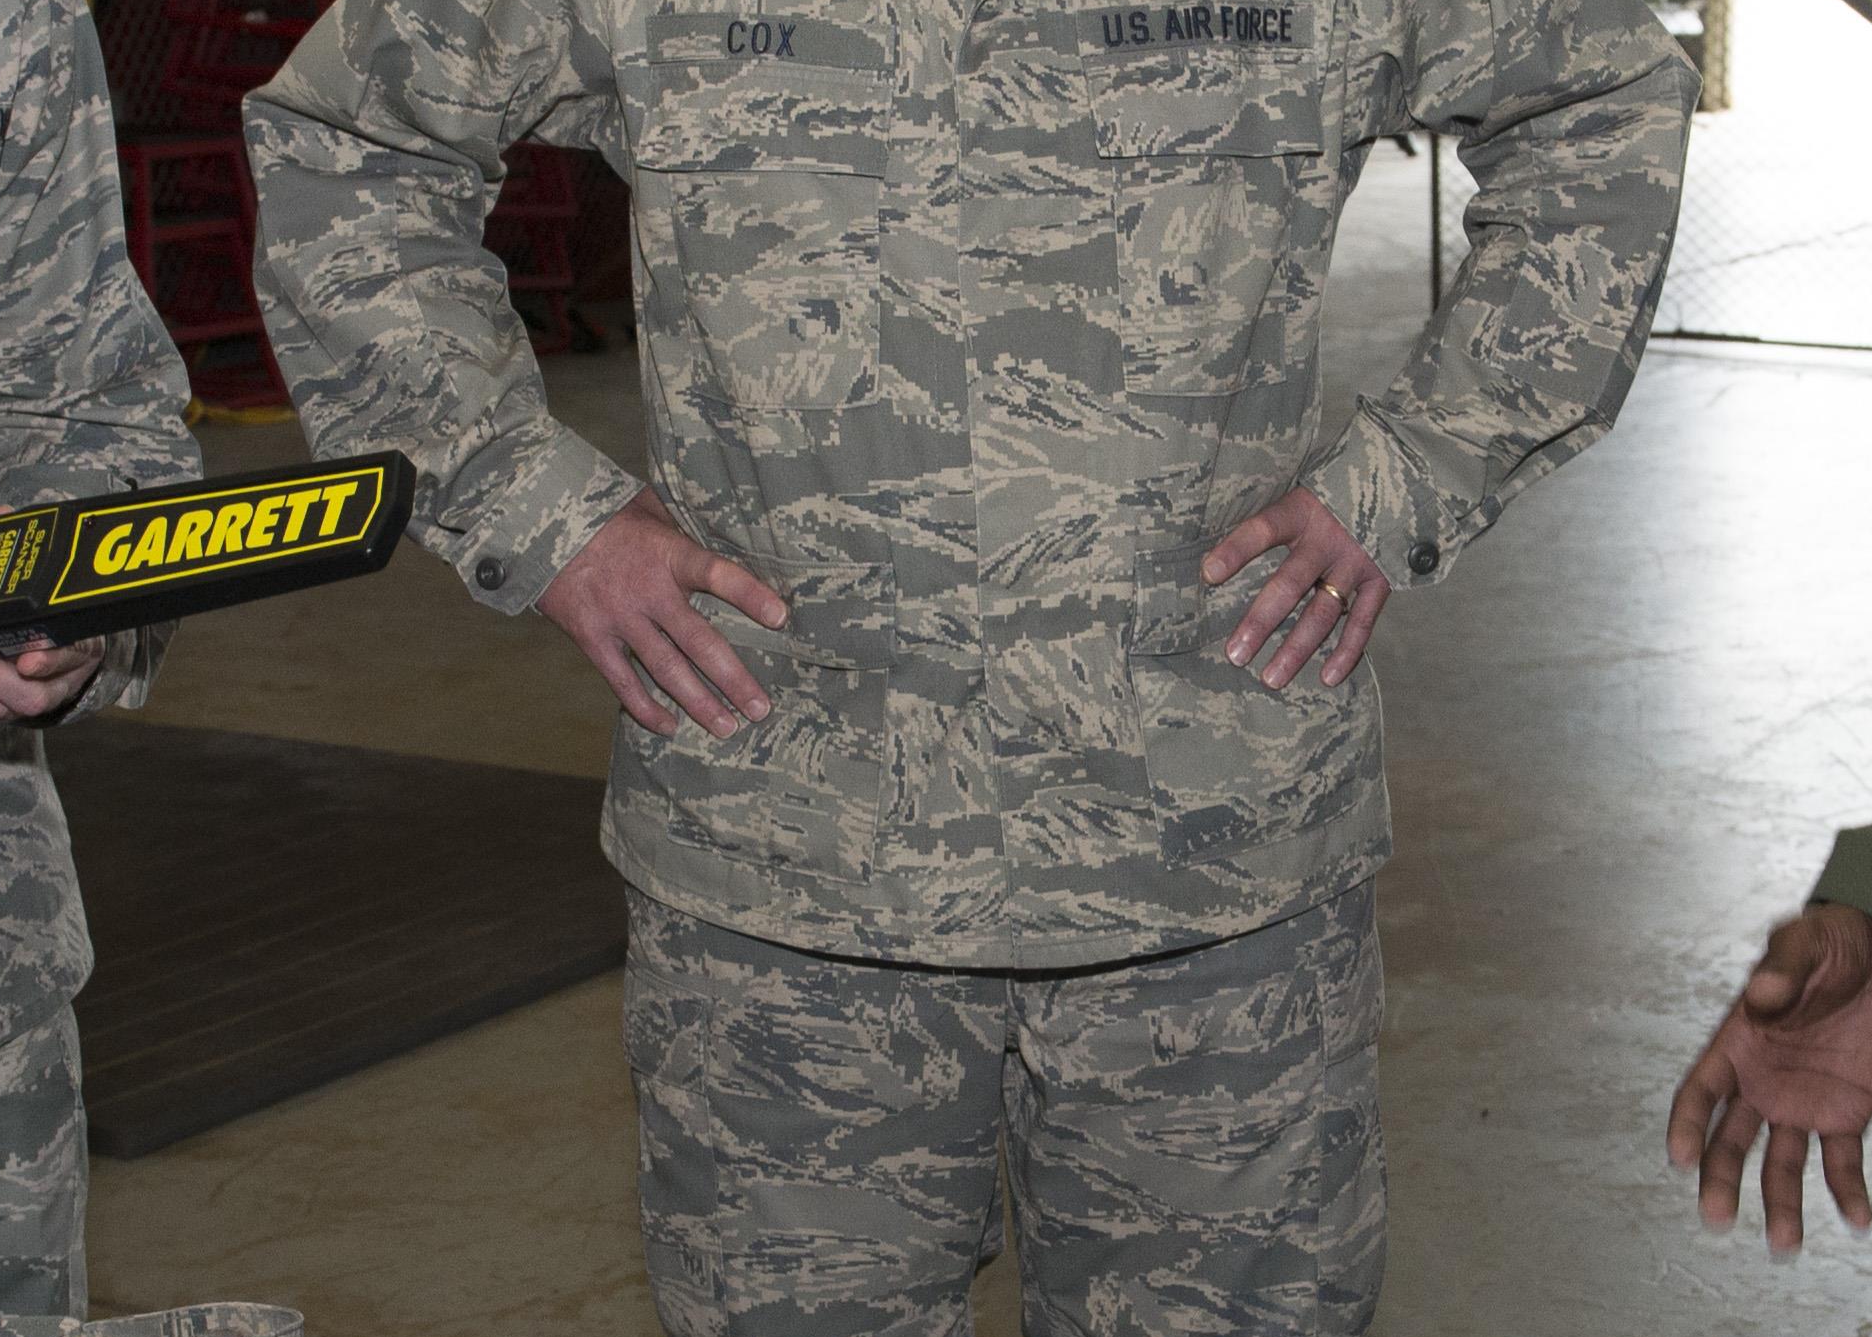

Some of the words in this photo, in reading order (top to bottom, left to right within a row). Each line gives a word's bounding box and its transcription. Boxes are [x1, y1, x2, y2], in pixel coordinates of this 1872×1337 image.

[726, 21, 796, 58] COX
[1102, 12, 1154, 46] U.S.
[1165, 5, 1213, 41] AIR
[1222, 3, 1293, 44] FORCE
[22, 529, 46, 581] SUPER
[93, 482, 359, 576] GARRETT
[4, 518, 39, 594] SCANNER
